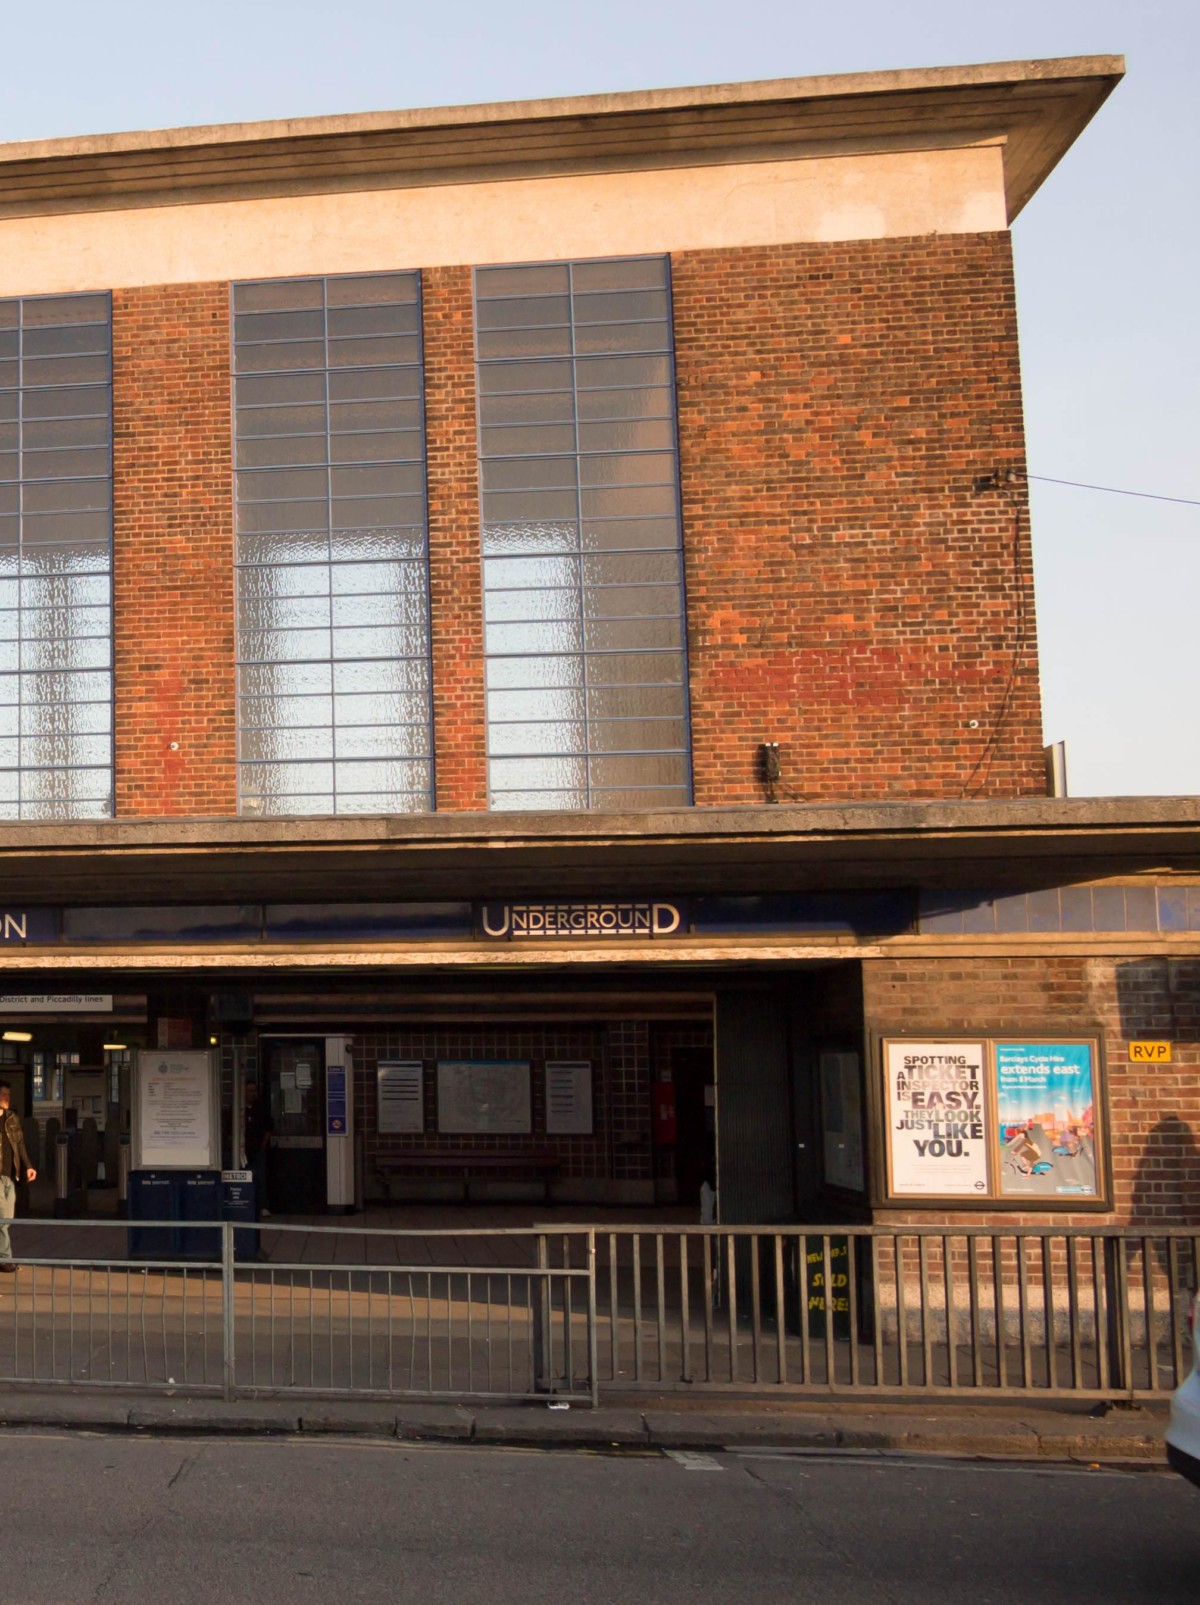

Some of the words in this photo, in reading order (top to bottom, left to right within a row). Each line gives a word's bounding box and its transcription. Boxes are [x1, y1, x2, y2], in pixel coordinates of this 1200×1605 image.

[482, 903, 680, 936] UNDERGROUND
[0, 995, 28, 1004] District
[30, 995, 45, 1004] and
[46, 995, 82, 1005] Piccadilly
[84, 994, 104, 1003] lines
[1133, 1045, 1167, 1058] RVP
[904, 1055, 966, 1065] SPOTTING
[999, 1055, 1028, 1064] Barclays
[1029, 1055, 1049, 1064] Cycle
[897, 1071, 906, 1080] A
[904, 1065, 979, 1080] TICKET
[1000, 1064, 1051, 1075] extends
[1052, 1064, 1081, 1075] east
[1000, 1075, 1018, 1083] from
[897, 1080, 979, 1091] INSPECTOR
[897, 1091, 911, 1101] IS
[911, 1091, 981, 1110] EASY.
[904, 1110, 934, 1119] THEY
[934, 1110, 982, 1122] LOOK
[896, 1119, 933, 1130] JUST
[933, 1123, 983, 1139] LIKE
[913, 1139, 970, 1157] YOU.
[812, 1272, 847, 1288] SLD
